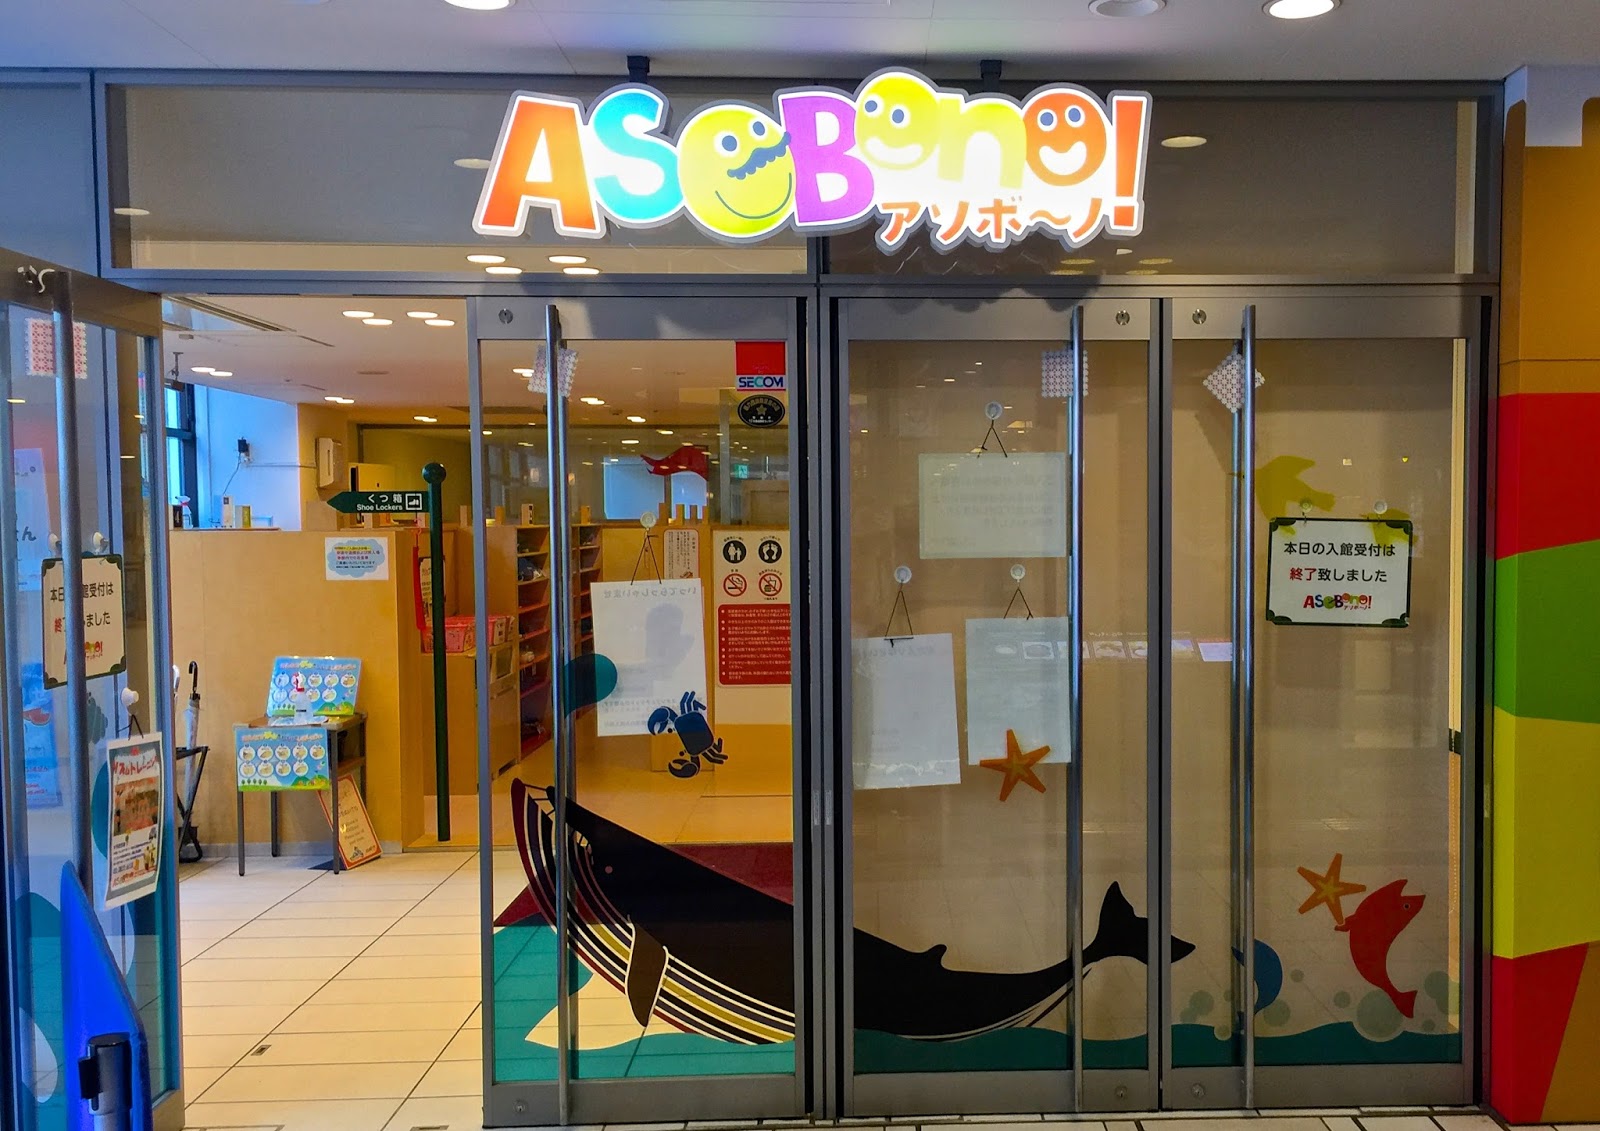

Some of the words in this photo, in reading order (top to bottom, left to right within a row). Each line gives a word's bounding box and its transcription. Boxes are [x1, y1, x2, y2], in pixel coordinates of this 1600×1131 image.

[738, 376, 784, 388] SECOM
[356, 503, 375, 511] Shoe
[375, 503, 403, 511] Lockers
[1283, 541, 1396, 558] 本日の入館受付は
[1289, 567, 1388, 583] 終了致しました
[50, 581, 114, 603] 本日館受付は
